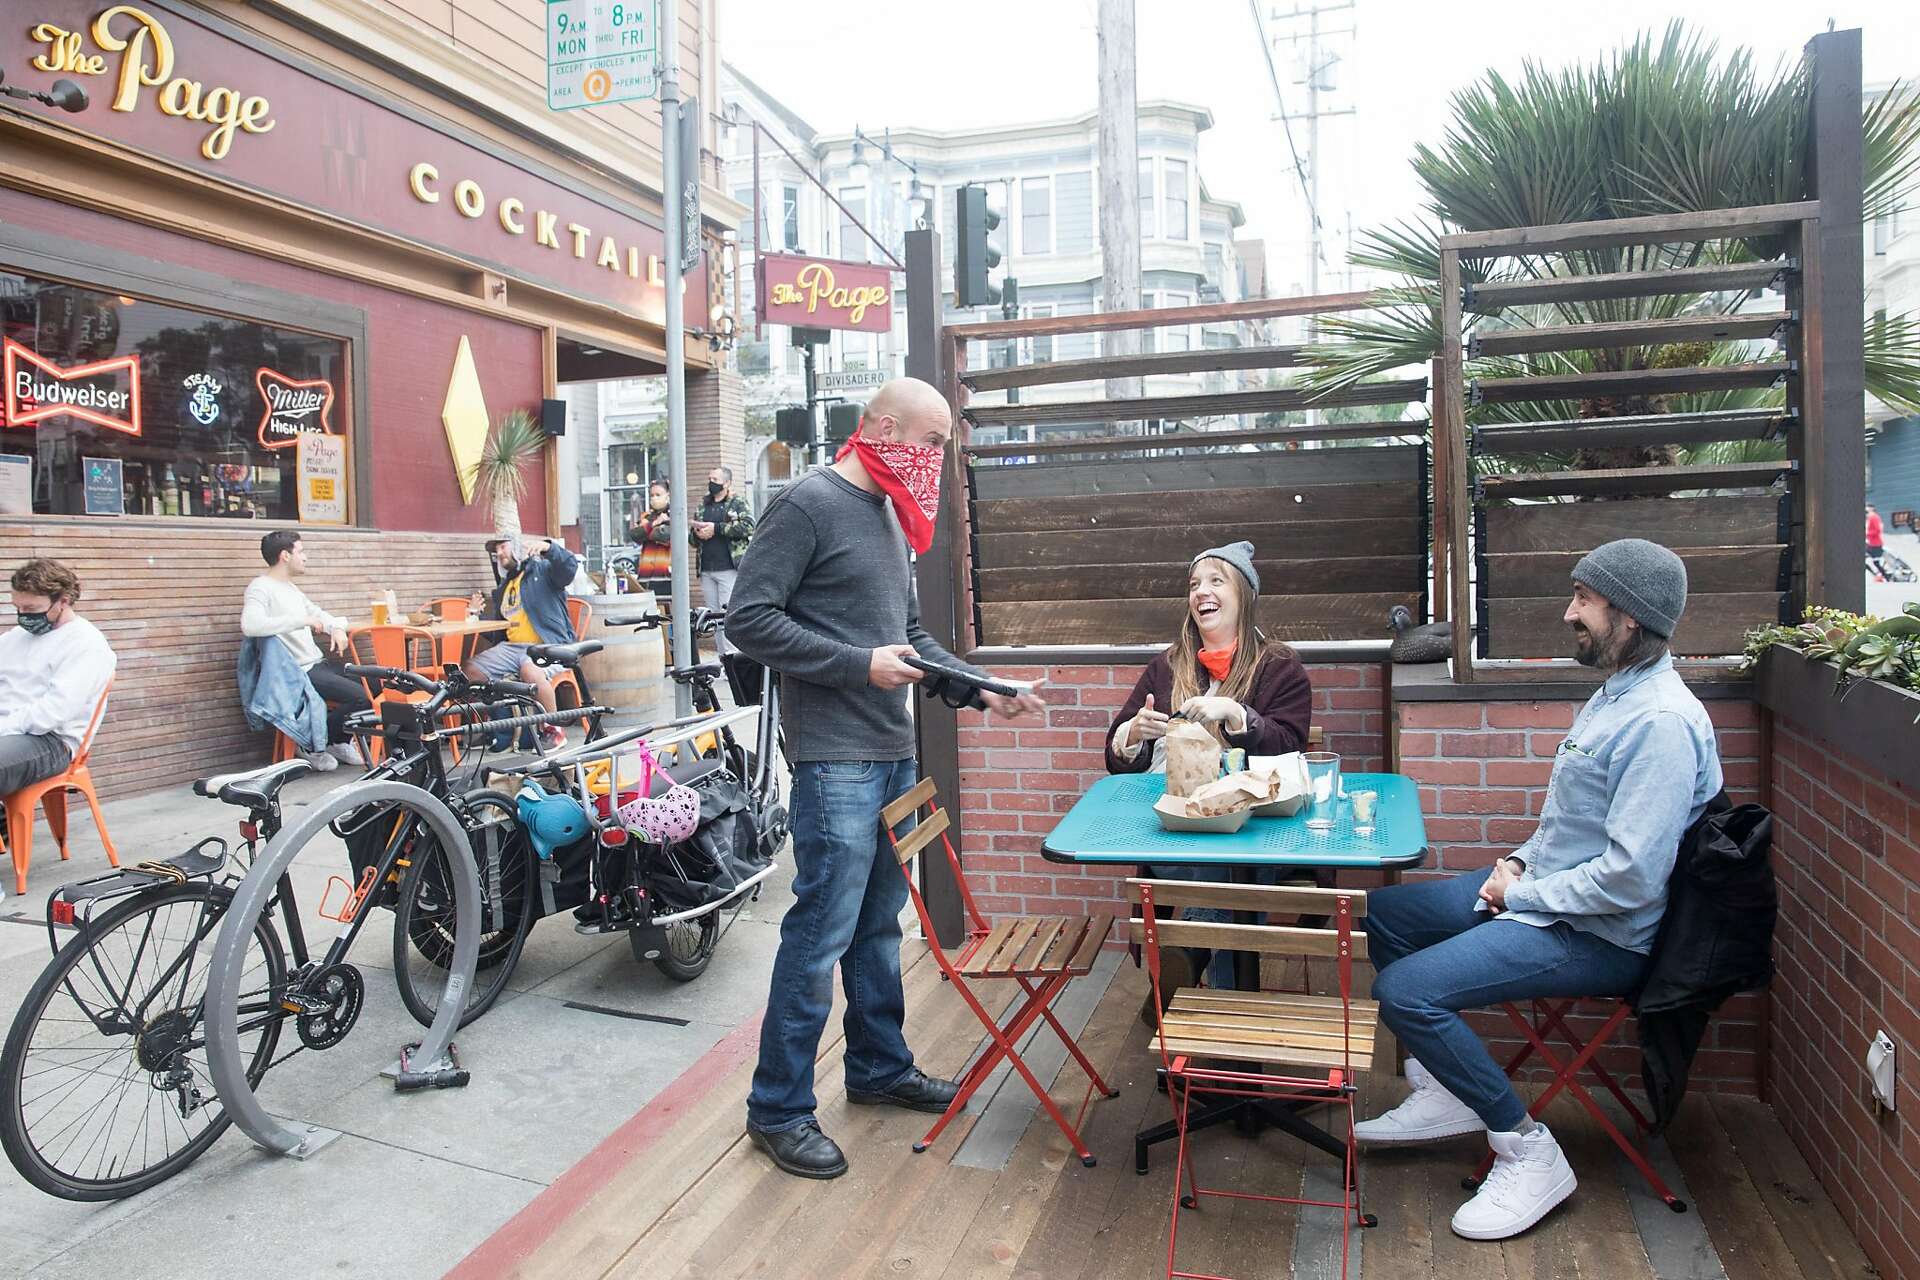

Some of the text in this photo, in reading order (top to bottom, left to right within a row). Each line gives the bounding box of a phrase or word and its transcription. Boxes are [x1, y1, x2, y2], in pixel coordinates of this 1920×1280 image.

[557, 13, 568, 34] 9
[593, 7, 602, 16] TO
[612, 4, 624, 26] 8
[557, 29, 643, 56] MON THRU FRI
[556, 54, 648, 75] EXCEPT VEHICLES WITH
[31, 5, 276, 160] The Page
[554, 87, 572, 96] AREA
[620, 75, 651, 87] PERMITS
[410, 162, 686, 294] COCKTAIL
[770, 263, 889, 325] The Page
[16, 371, 130, 409] Budweiser
[183, 373, 222, 394] STEAM
[825, 372, 885, 387] DIVISADERO
[267, 383, 326, 410] Miller
